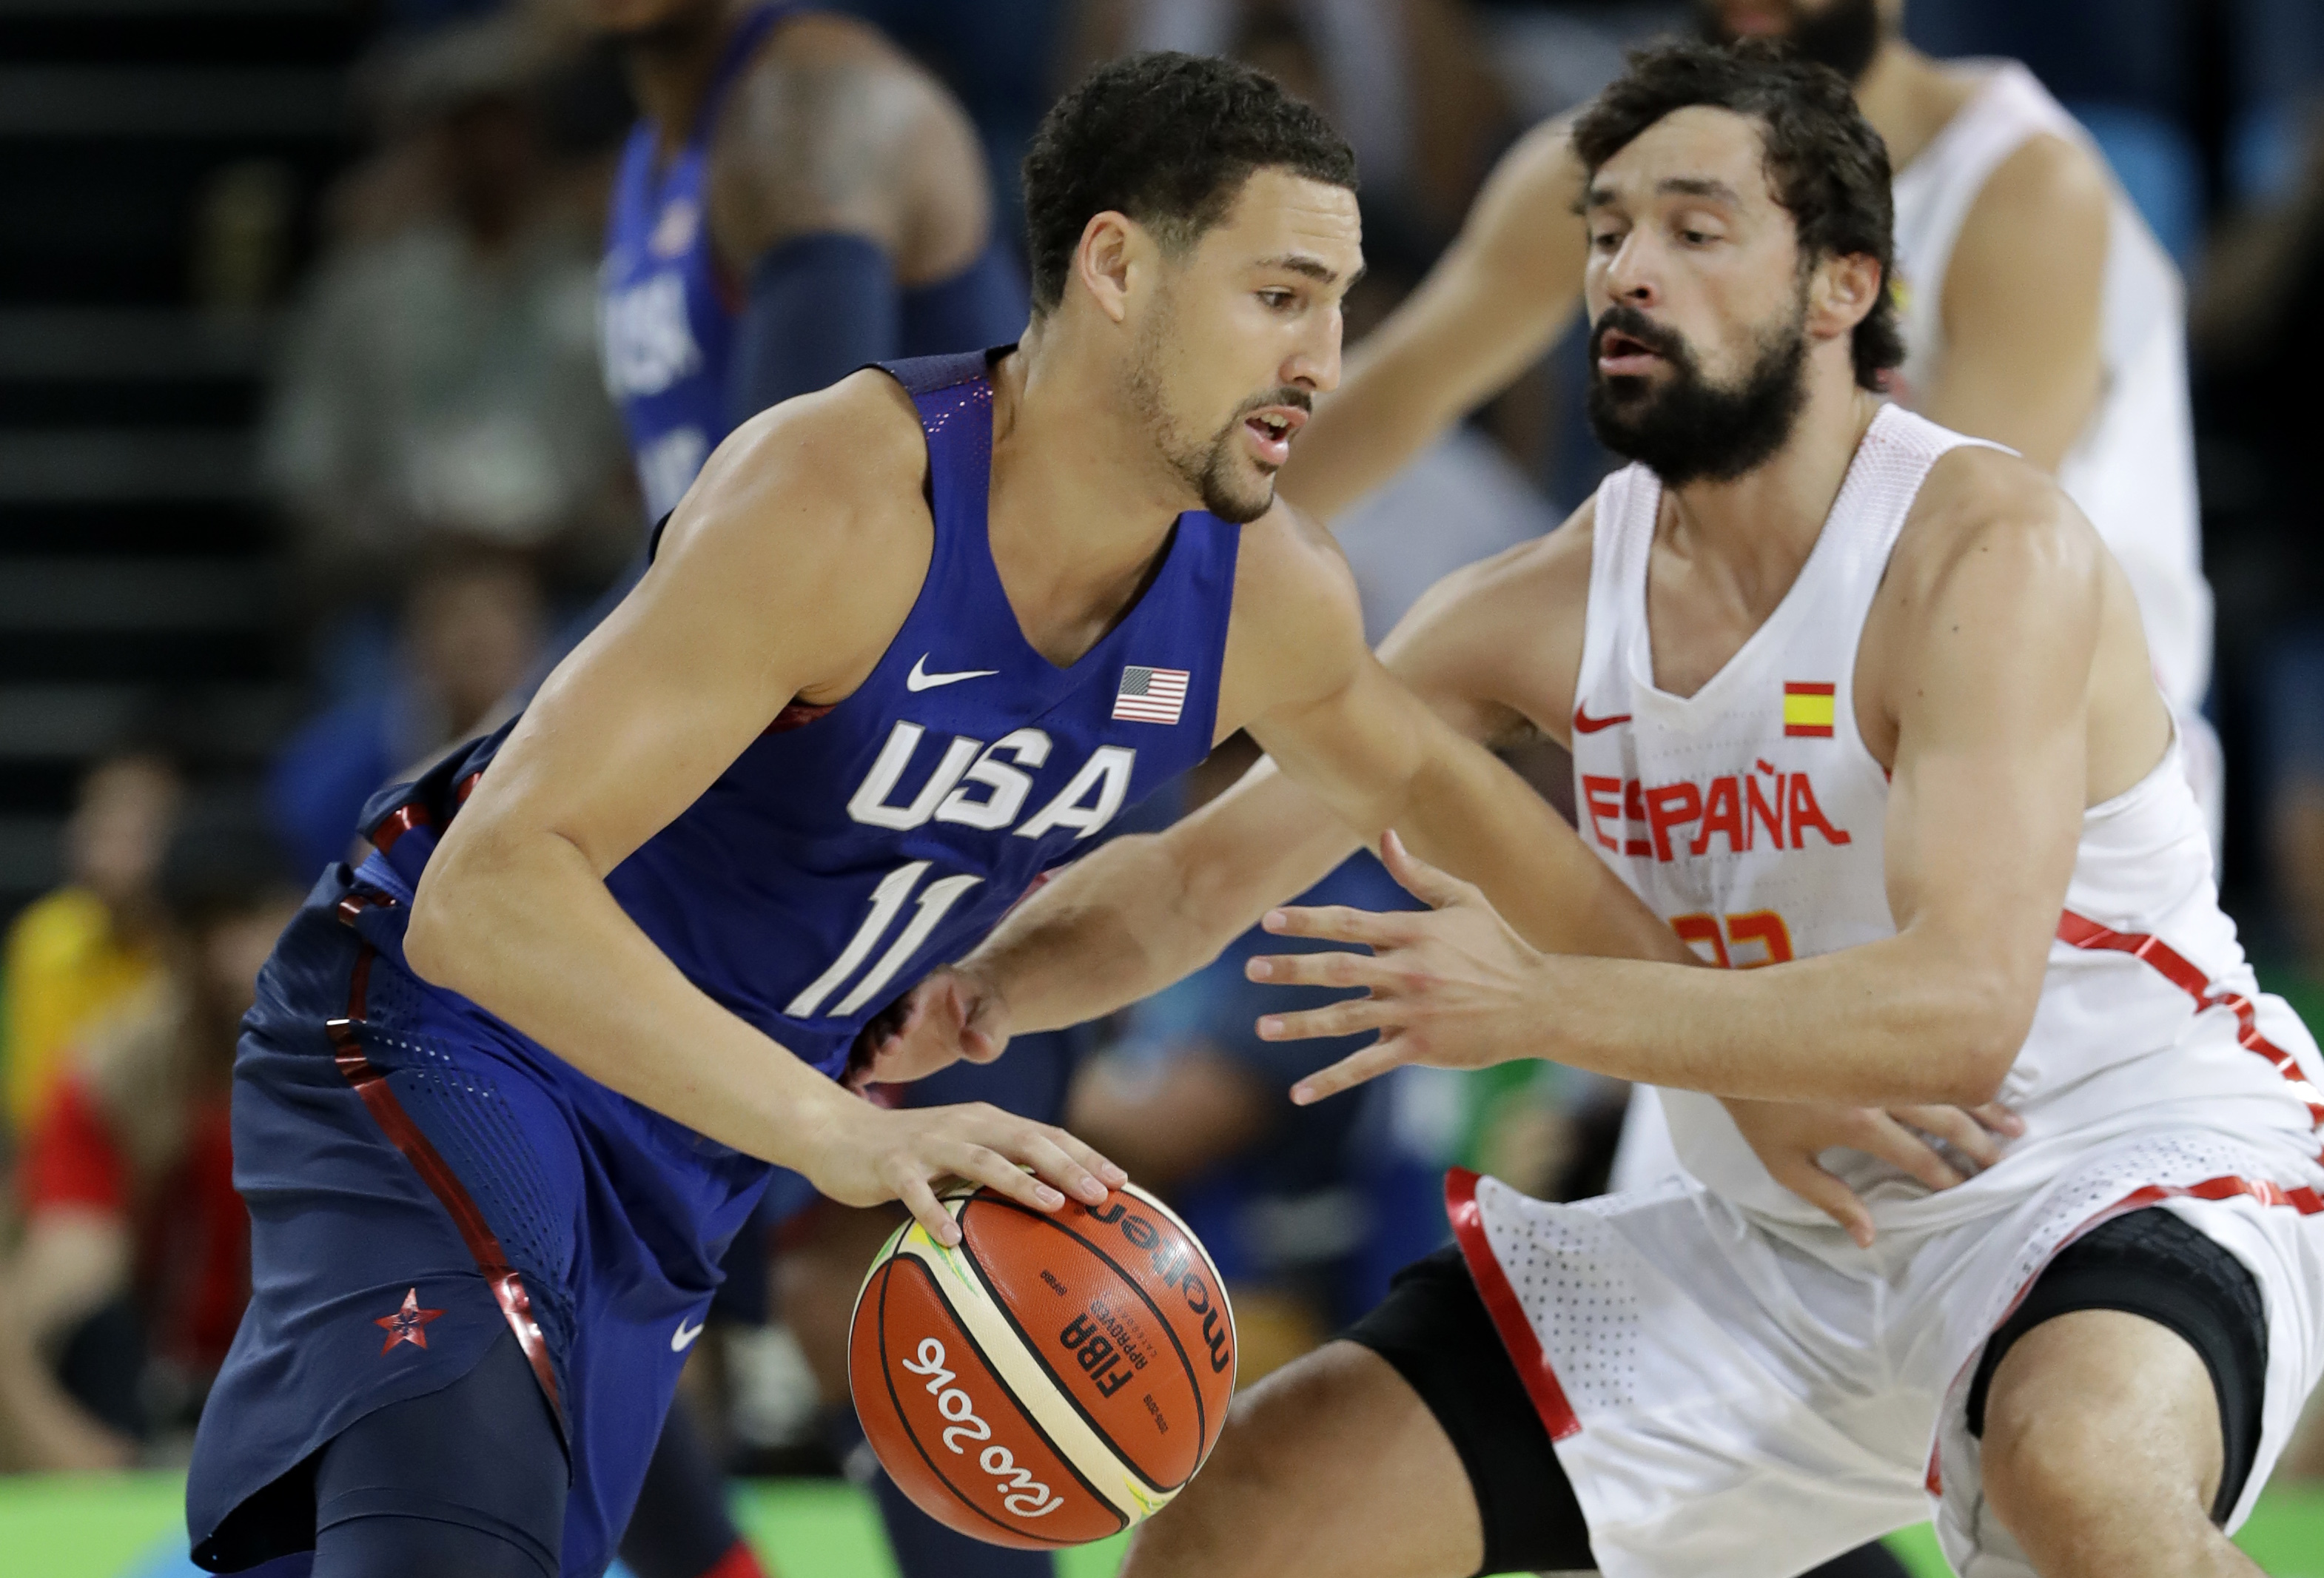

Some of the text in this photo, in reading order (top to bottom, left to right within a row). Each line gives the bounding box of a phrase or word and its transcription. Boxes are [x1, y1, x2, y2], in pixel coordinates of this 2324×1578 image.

[846, 719, 1137, 840] USA
[1582, 756, 1852, 863] ESPAÑA
[782, 859, 986, 1018] 11
[1085, 1203, 1229, 1374] molten
[1090, 1299, 1147, 1370] APPROVED
[1060, 1312, 1134, 1399] FIBA
[902, 1337, 1064, 1517] Rio 2016
